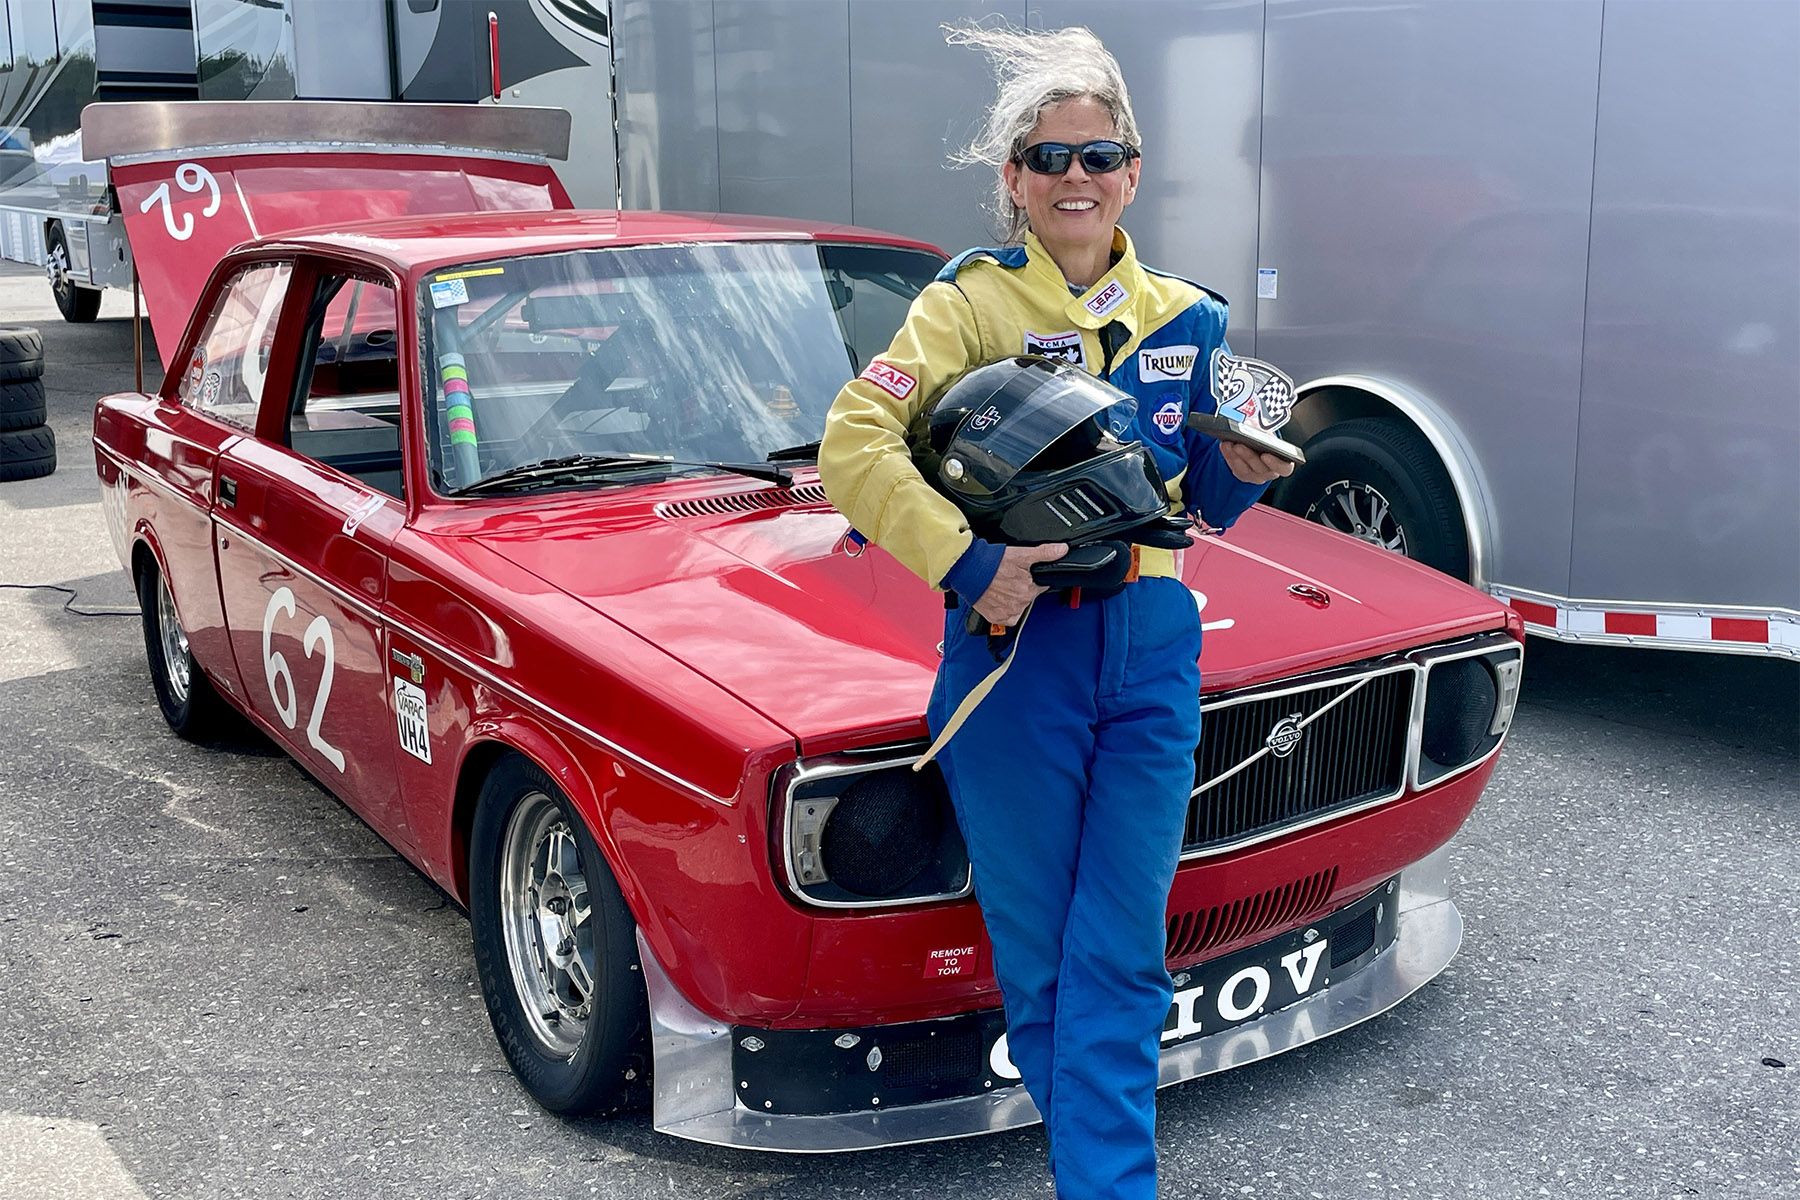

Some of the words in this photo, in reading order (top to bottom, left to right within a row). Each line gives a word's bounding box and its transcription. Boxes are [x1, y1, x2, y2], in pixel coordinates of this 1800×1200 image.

[1090, 286, 1118, 311] LEAF
[1038, 340, 1067, 349] WCMA
[868, 362, 912, 388] EAF
[1219, 368, 1255, 424] 2
[1155, 414, 1183, 426] VOLV
[263, 586, 345, 774] 62
[397, 693, 426, 723] VARAC
[397, 711, 429, 759] VH4
[1271, 731, 1301, 746] VOLVO
[930, 946, 975, 959] REMOVE
[944, 958, 958, 967] TO
[937, 967, 961, 976] TOW
